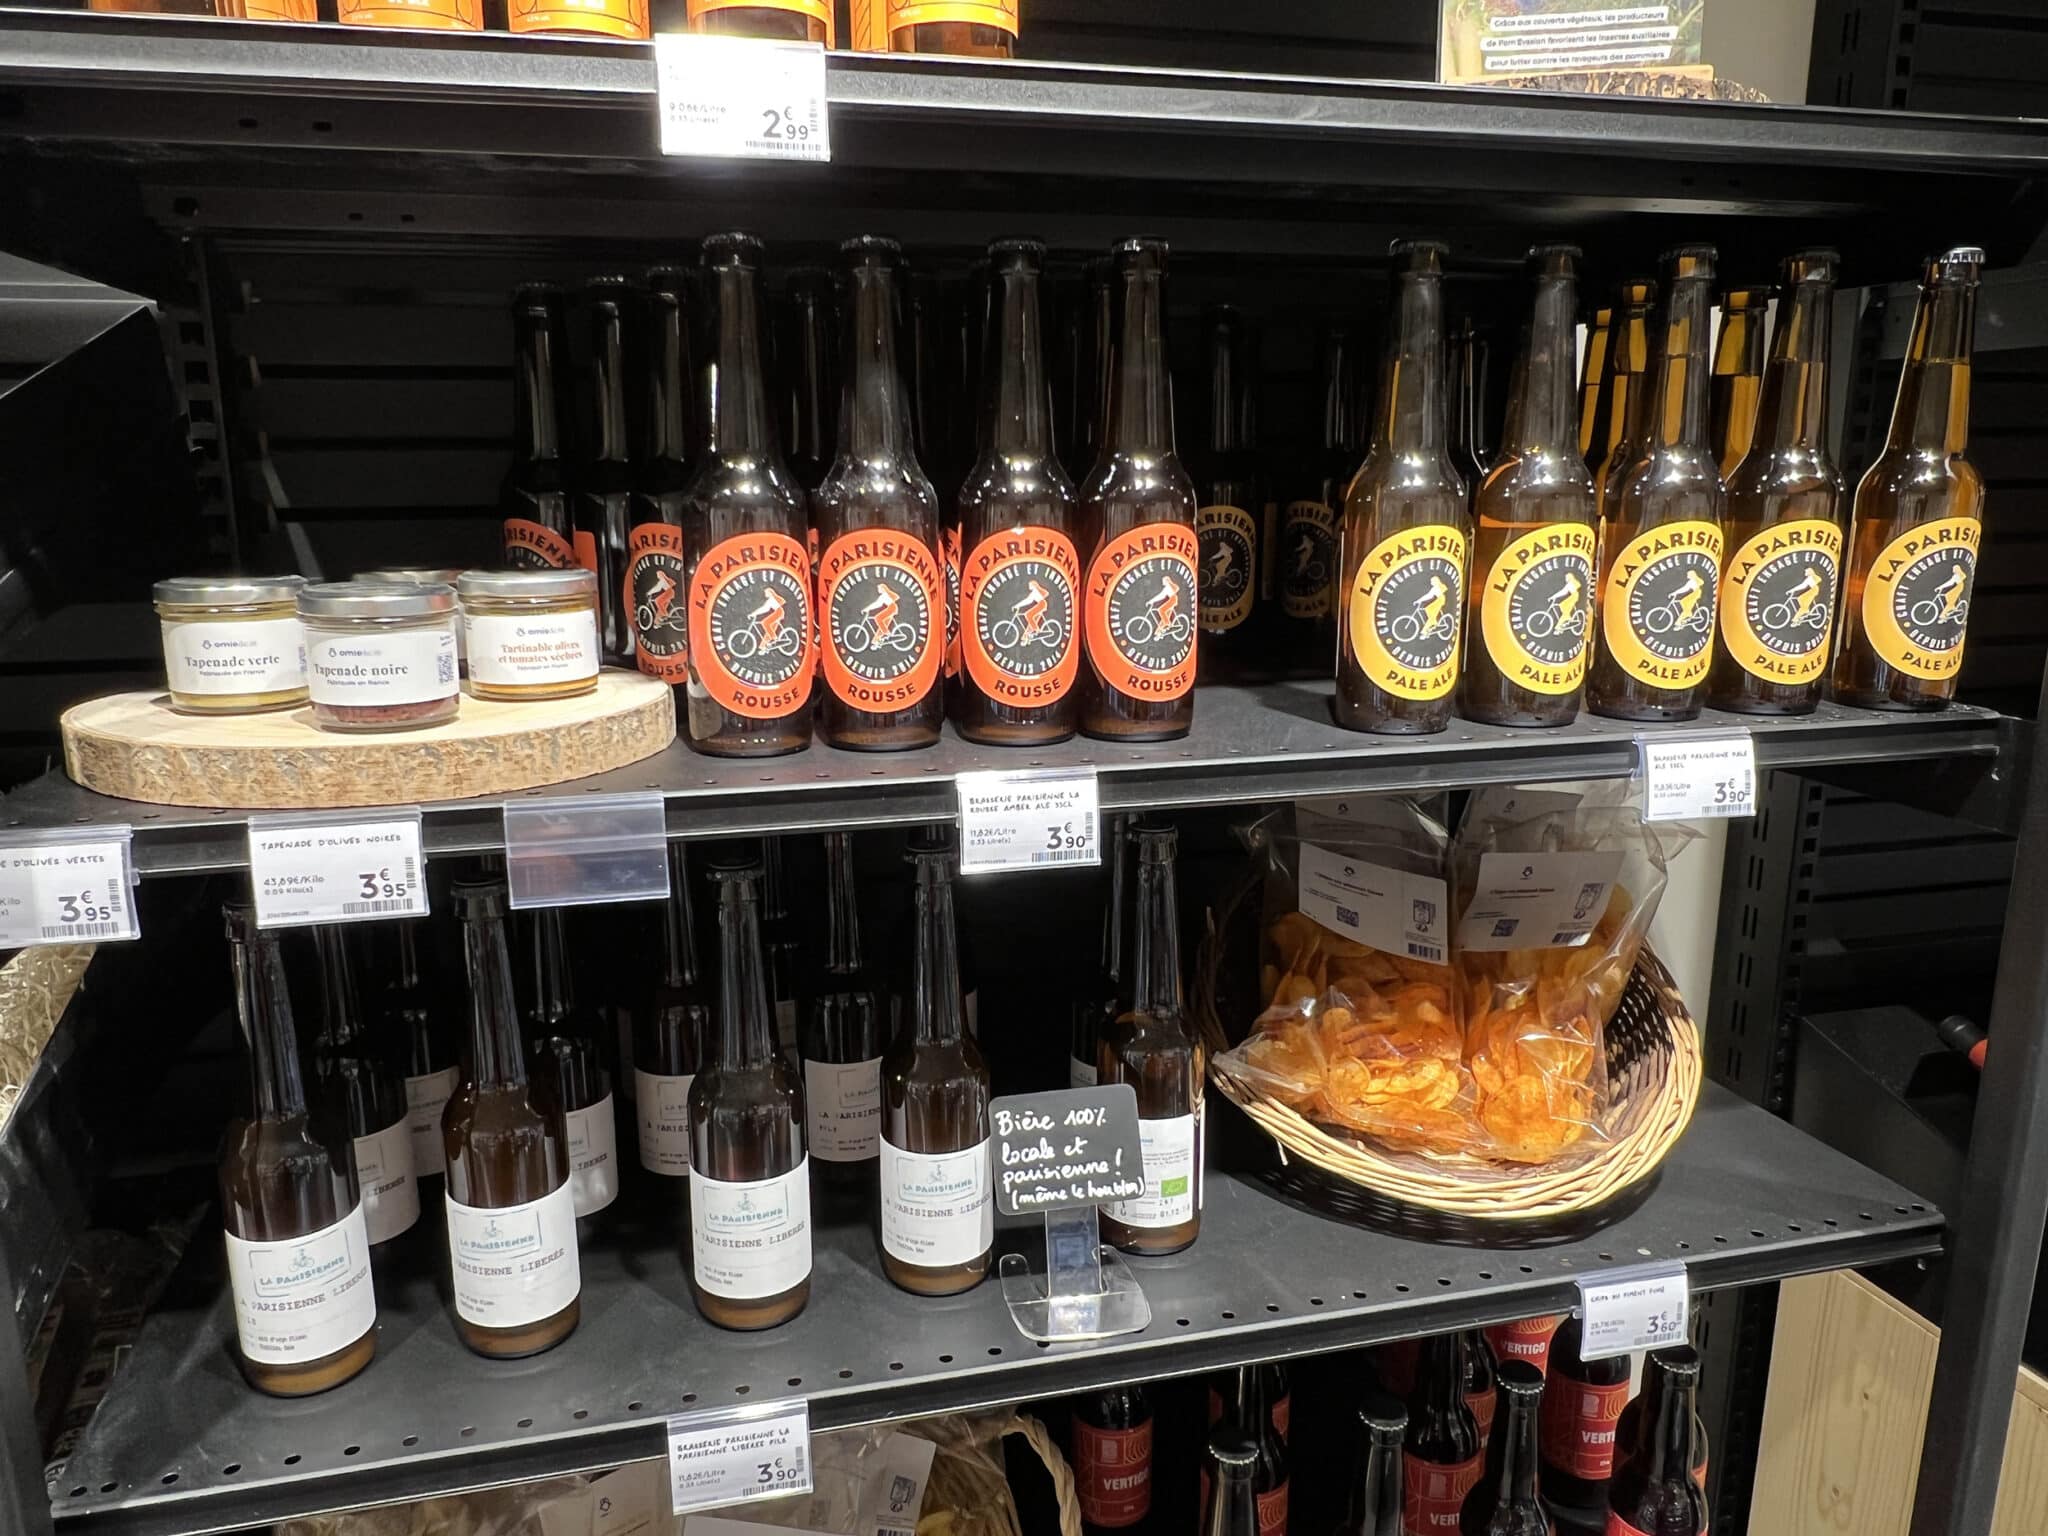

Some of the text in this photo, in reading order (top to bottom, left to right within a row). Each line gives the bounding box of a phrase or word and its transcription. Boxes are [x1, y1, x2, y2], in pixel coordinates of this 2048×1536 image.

[1493, 567, 1518, 593] LA
[1615, 563, 1640, 589] LA
[1732, 560, 1756, 585] LA
[1877, 558, 1904, 583] LA
[821, 578, 834, 604] LA
[965, 575, 981, 601] LA
[1093, 571, 1114, 597] LA
[1360, 570, 1382, 597] LA
[695, 582, 713, 610] LA
[184, 655, 280, 669] Tapenade verte
[314, 664, 409, 677] Tapenade noire
[1638, 659, 1680, 679] PALE
[1753, 654, 1796, 675] PALE
[1901, 652, 1941, 671] PALE
[1127, 671, 1189, 693] ROUSSE
[1386, 670, 1427, 690] PALE
[1519, 664, 1561, 684] PALE
[732, 687, 801, 709] ROUSSE
[847, 682, 917, 703] ROUSSE
[994, 678, 1062, 698] ROUSSE
[261, 834, 401, 850] TAPENADE D'OLIVES NOIRES
[14, 855, 105, 867] D'OLIVES VERTES
[995, 1107, 1107, 1136] Bière 100%
[1002, 1136, 1089, 1166] locale et
[1003, 1160, 1110, 1193] parisienne
[1012, 1186, 1068, 1210] (même
[1071, 1183, 1085, 1199] le
[276, 1256, 345, 1285] PARISIENNE
[678, 1428, 790, 1452] BRASSERIE PARISIENNE LA
[1581, 1430, 1616, 1444] VERTI
[678, 1447, 727, 1460] PARISIENNE
